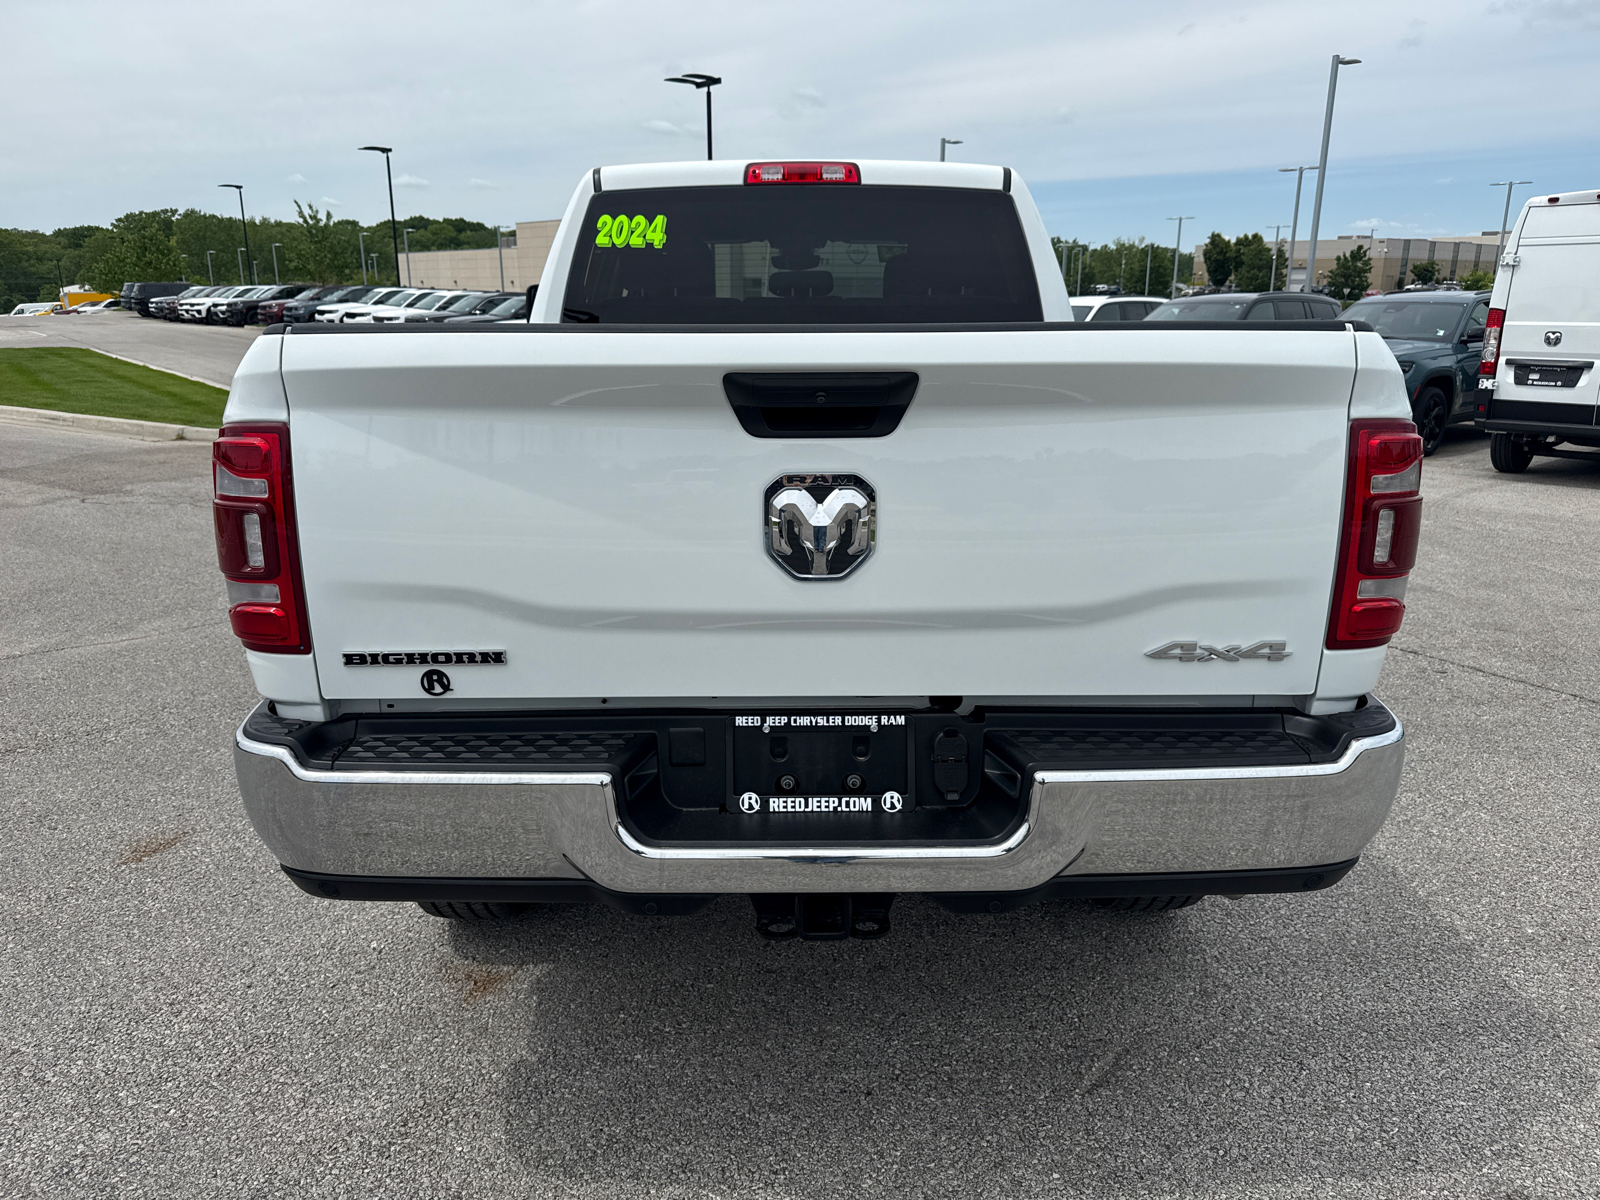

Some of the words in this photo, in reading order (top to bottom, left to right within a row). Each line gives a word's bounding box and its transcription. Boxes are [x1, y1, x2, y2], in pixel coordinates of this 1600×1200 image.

[595, 214, 667, 249] 2024
[784, 475, 854, 486] RAM
[342, 650, 507, 667] BIGHORN
[735, 716, 761, 726] REED
[764, 716, 788, 726] JEEP
[790, 715, 842, 726] CHRYSLER
[844, 715, 878, 726] DODGE
[881, 715, 906, 726] RAM
[769, 797, 872, 812] REEDJEEP.COM
